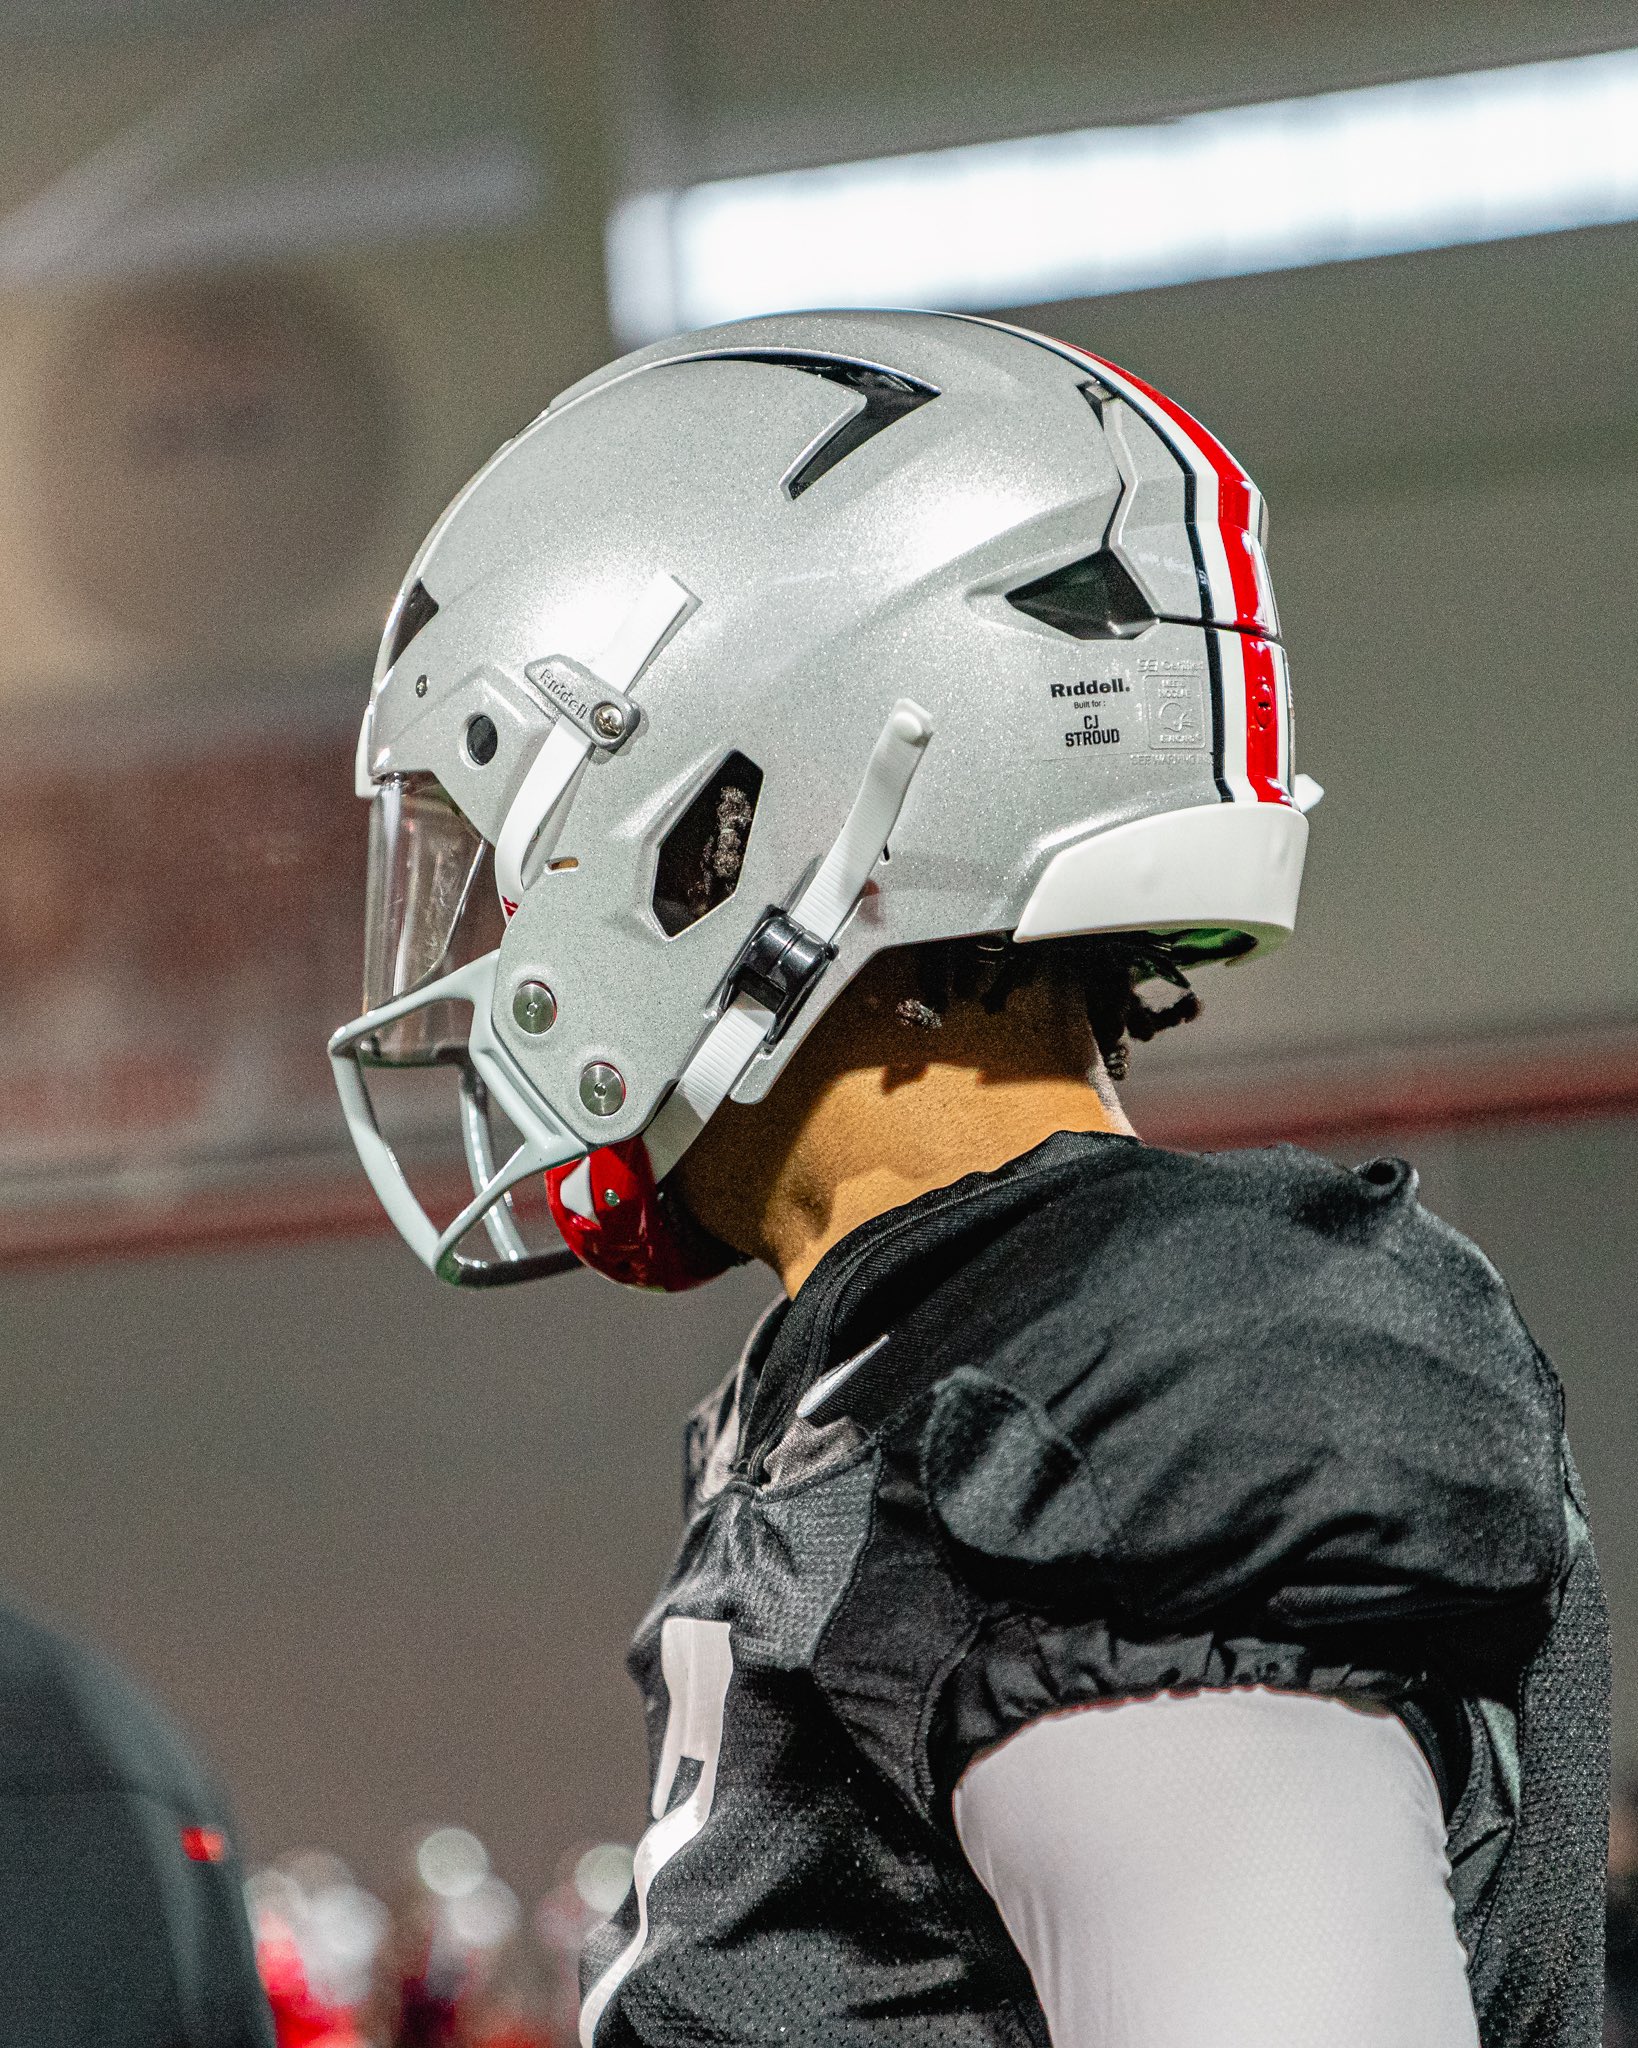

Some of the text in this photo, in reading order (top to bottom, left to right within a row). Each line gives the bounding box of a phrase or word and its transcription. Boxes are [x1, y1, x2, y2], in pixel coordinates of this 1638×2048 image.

[538, 668, 589, 720] Riddell
[1073, 700, 1091, 709] Built
[1083, 714, 1099, 730] CJ
[1065, 728, 1120, 748] STROUD
